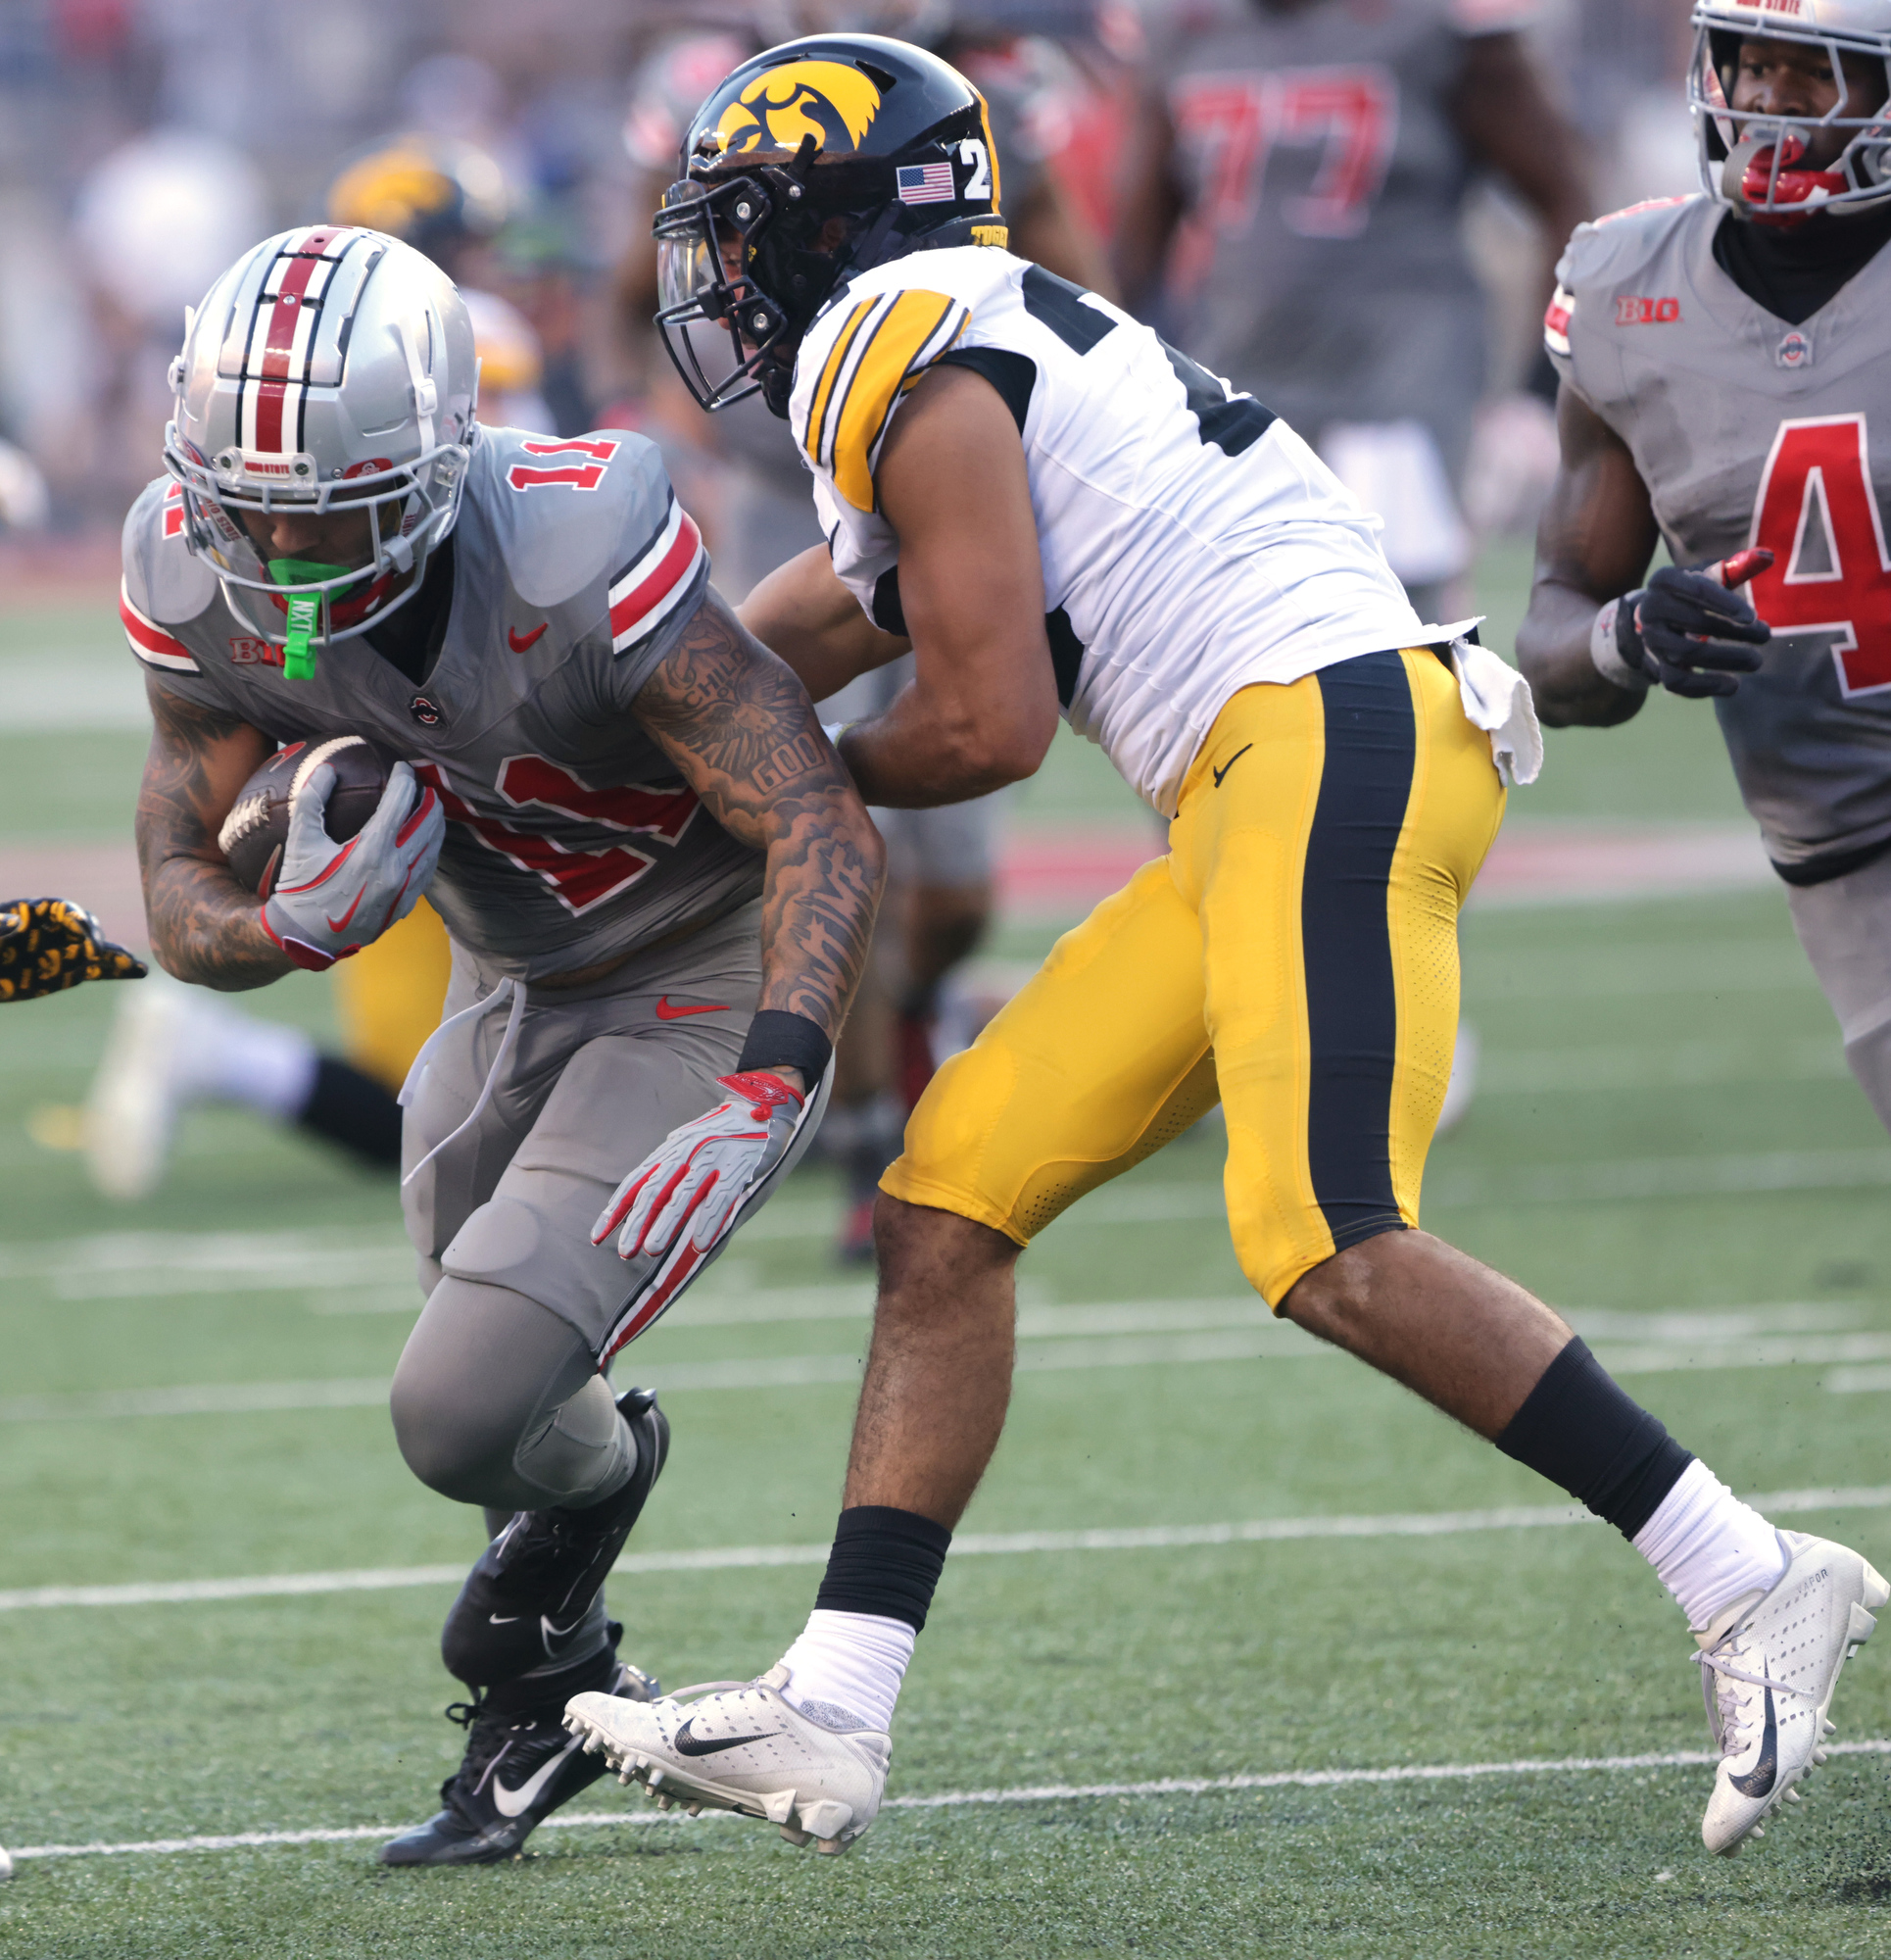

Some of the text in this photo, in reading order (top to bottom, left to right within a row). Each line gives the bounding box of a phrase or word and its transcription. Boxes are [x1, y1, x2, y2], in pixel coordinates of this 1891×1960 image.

[959, 138, 991, 201] 2
[505, 438, 622, 492] 11
[216, 515, 242, 542] STATE
[1745, 412, 1891, 700] 4
[682, 649, 748, 708] CHILD
[751, 731, 827, 797] GOD
[412, 753, 701, 919] 11
[1797, 1568, 1829, 1595] VAPOR
